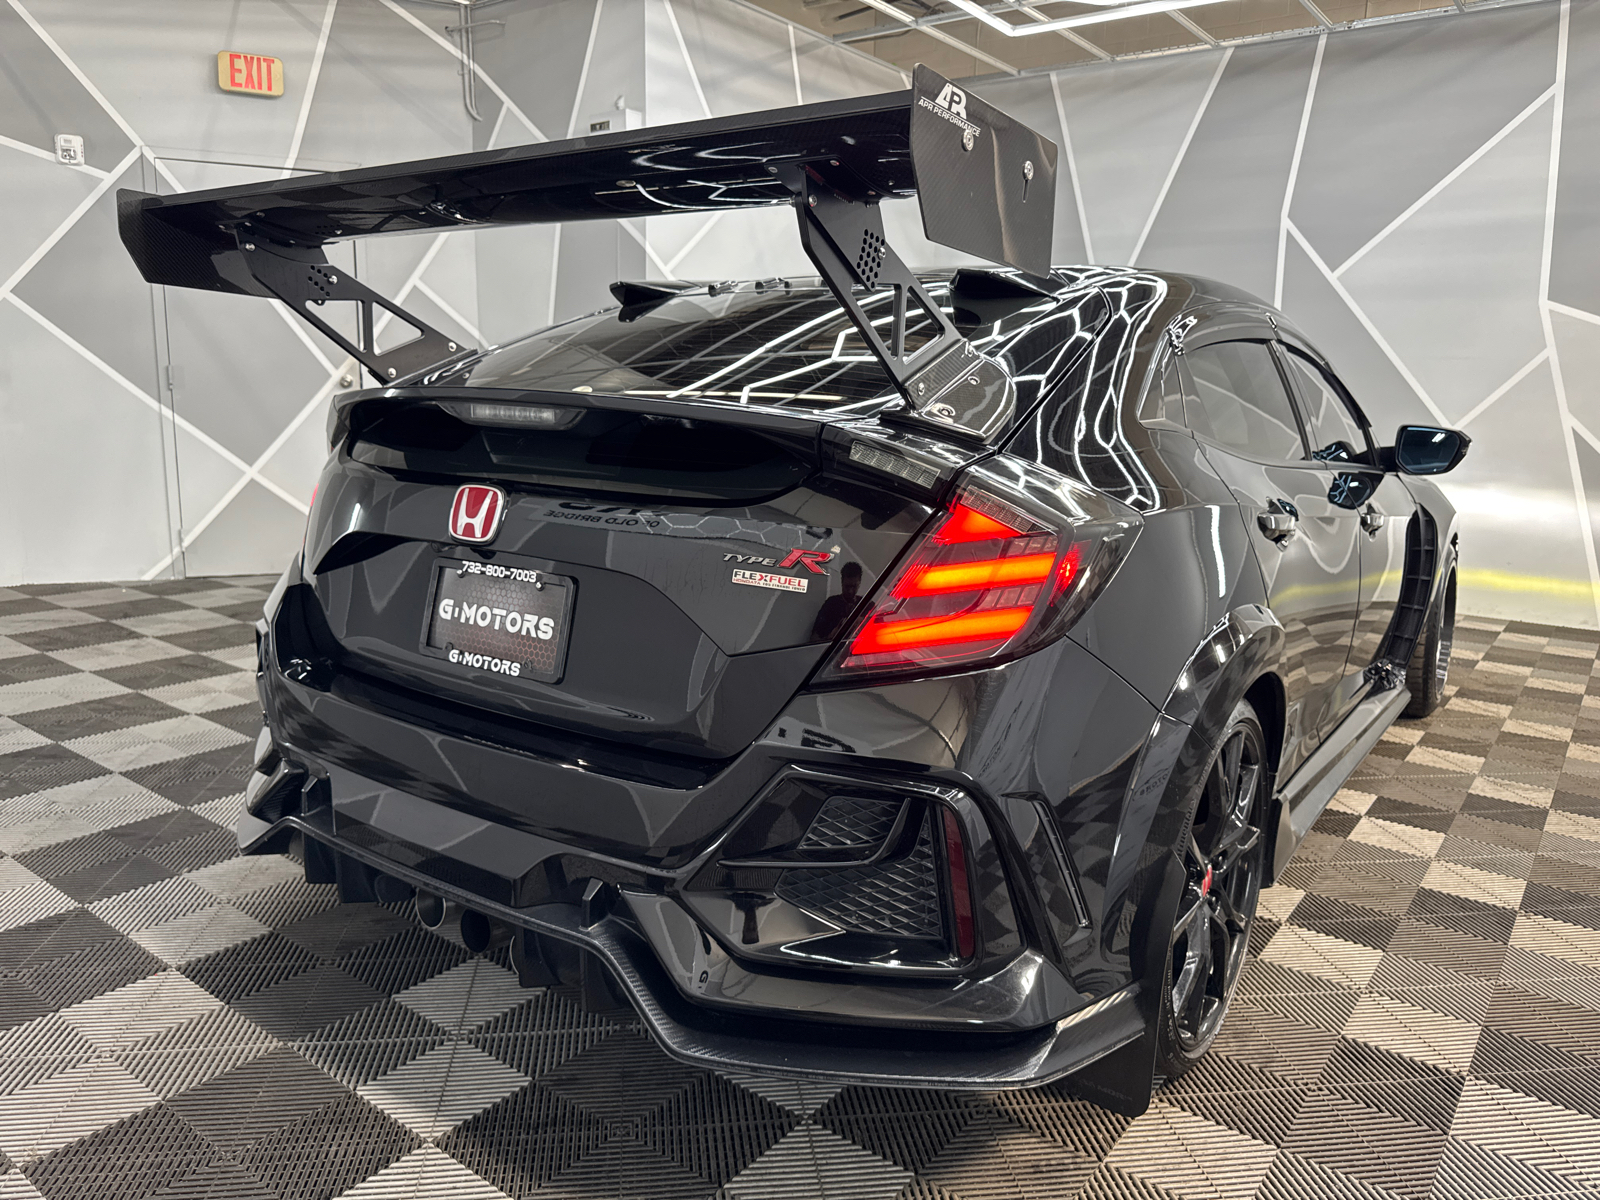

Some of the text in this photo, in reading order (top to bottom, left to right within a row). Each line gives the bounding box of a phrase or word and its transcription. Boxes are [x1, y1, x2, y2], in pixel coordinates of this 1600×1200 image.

[229, 53, 275, 92] EXIT
[918, 99, 981, 137] APR PERFORMANCE
[461, 560, 537, 583] 732-800-7003
[723, 547, 835, 576] TYPE R
[733, 570, 806, 588] FLEXFUEL
